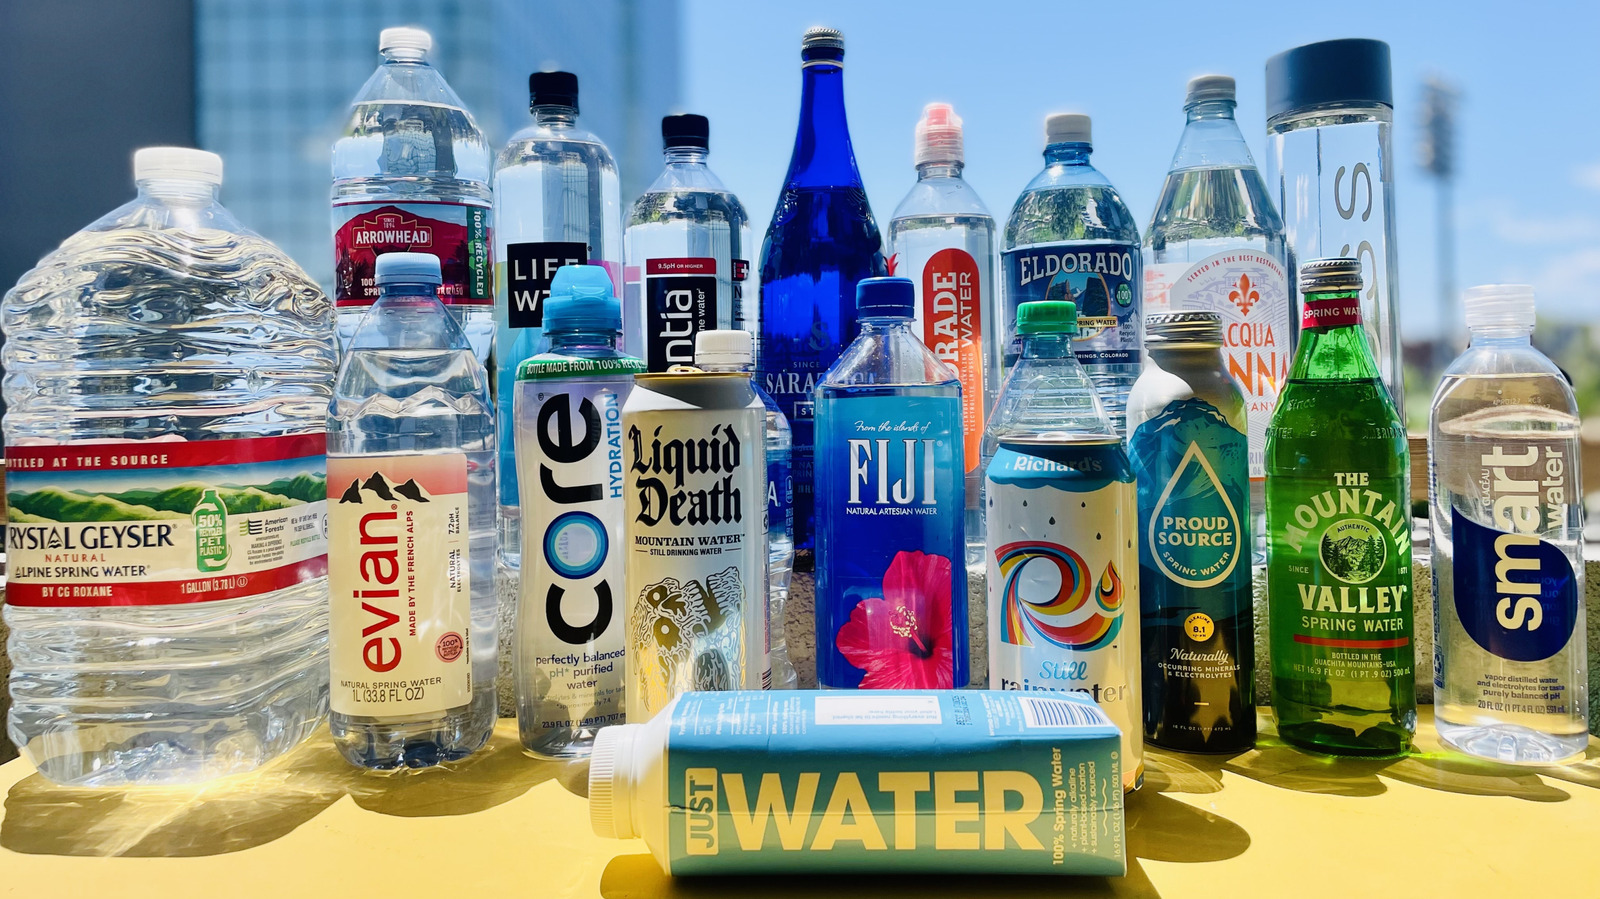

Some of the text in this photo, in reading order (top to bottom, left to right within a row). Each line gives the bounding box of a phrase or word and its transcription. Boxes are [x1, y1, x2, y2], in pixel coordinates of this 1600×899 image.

[356, 230, 428, 244] ARROWHEAD
[473, 210, 484, 295] 100% RECYCLED
[1020, 252, 1132, 286] ELDORADO
[1187, 265, 1209, 282] SERVED
[1212, 259, 1220, 267] IN
[1222, 256, 1236, 264] THE
[696, 291, 705, 317] water
[960, 272, 972, 348] WATER
[1304, 307, 1339, 319] SPRING
[1095, 318, 1116, 326] WATER
[527, 360, 621, 374] BOTTLE MADE FROM 100%
[854, 420, 931, 434] From the islands of
[604, 394, 622, 498] HYDRATION
[53, 457, 67, 467] AT
[77, 457, 101, 466] THE
[110, 454, 168, 465] SOURCE
[628, 424, 740, 489] Liquid
[848, 439, 937, 504] FIJI
[1014, 457, 1102, 472] Richard's
[1334, 473, 1369, 486] THE
[1542, 446, 1563, 528] water
[635, 475, 742, 526] Death
[846, 507, 877, 515] NATURAL
[199, 514, 222, 527] 50%
[265, 517, 288, 525] American
[536, 393, 613, 644] core
[1163, 517, 1228, 530] PROUD
[1284, 488, 1411, 556] MOUNTAIN
[200, 528, 222, 536] RECYCLED
[265, 525, 284, 533] Forests
[1337, 523, 1369, 533] AUTHENTIC
[200, 536, 222, 546] PET
[635, 534, 741, 546] MOUNTAIN WATER
[1158, 532, 1232, 546] SOURCE
[1481, 446, 1543, 631] smart
[45, 554, 106, 562] NATURAL
[407, 535, 415, 572] FRENCH
[650, 548, 666, 556] STILL
[667, 548, 698, 556] DRINKING
[1162, 551, 1230, 576] SPRING WATER
[1288, 565, 1309, 573] SINCE
[16, 565, 147, 578] ALPINE SPRING WATER
[42, 586, 112, 597] BY CG ROXANE
[186, 578, 228, 593] GALLON (3.78
[352, 510, 401, 672] evian
[409, 596, 416, 608] BY
[1297, 583, 1403, 613] VALLEY
[1301, 616, 1403, 632] SPRING WATER
[536, 653, 579, 666] perfectly
[1170, 648, 1228, 665] Naturally
[1314, 658, 1345, 667] OUACHITA
[1332, 652, 1359, 660] BOTTLED
[574, 662, 613, 679] purified
[1039, 661, 1088, 681] Still
[1158, 662, 1240, 672] OCCURRING MINERALS
[1294, 664, 1304, 672] NET
[1307, 666, 1321, 674] 16.9
[1324, 668, 1333, 676] FL
[1360, 670, 1369, 678] PT
[1381, 670, 1392, 678] OZ)
[1393, 668, 1403, 676] 500
[341, 677, 441, 689] NATURAL SPRING WATER
[567, 680, 597, 689] water
[1484, 674, 1506, 682] vapor
[1508, 675, 1537, 683] distilled
[1492, 682, 1536, 691] electrolytes
[352, 686, 424, 704] 1L (33.8 FL OZ)
[1483, 689, 1509, 698] purely
[1511, 691, 1548, 699] balanced
[1478, 700, 1503, 710] 20 FL OZ
[595, 716, 606, 724] PT)
[1112, 761, 1118, 773] ML
[721, 771, 1045, 850] WATER
[1051, 747, 1067, 865] 100% Spring Water
[1068, 768, 1079, 841] naturally alkaline
[1078, 763, 1088, 846] plant-based carton
[1088, 761, 1098, 846] sustainably sourced
[689, 779, 715, 848] JUST
[1113, 823, 1120, 832] OZ
[1114, 834, 1120, 842] FL
